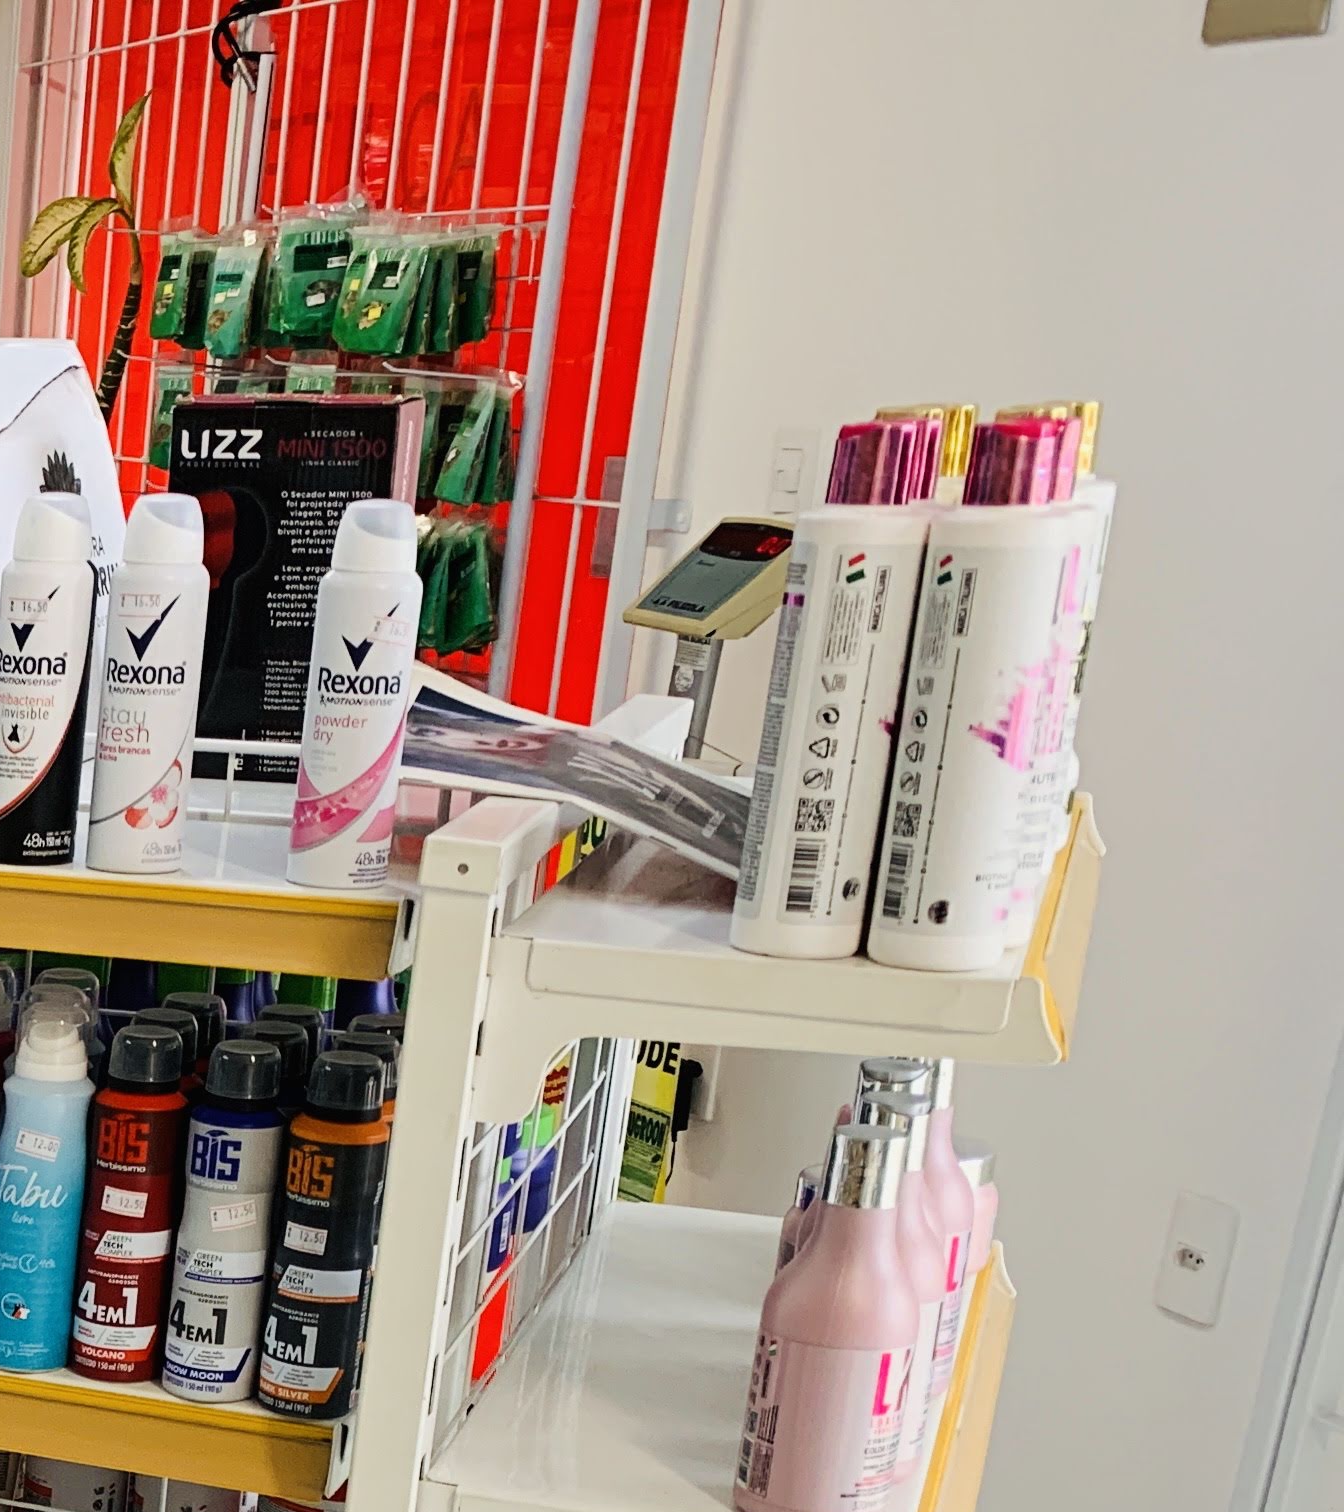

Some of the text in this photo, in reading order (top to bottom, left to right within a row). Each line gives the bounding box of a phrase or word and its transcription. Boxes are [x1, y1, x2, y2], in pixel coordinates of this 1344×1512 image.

[181, 429, 262, 459] LIZZ
[278, 440, 386, 458] MINI 1500
[107, 658, 185, 686] Rexona
[318, 668, 400, 695] Rexona
[101, 707, 147, 726] stay
[315, 714, 367, 729] powder
[100, 723, 150, 743] fresh
[313, 728, 333, 744] dry
[104, 1241, 123, 1249] TECH
[81, 1348, 125, 1360] VOLCANO
[190, 1370, 224, 1382] MOON
[278, 1386, 310, 1400] SILVER
